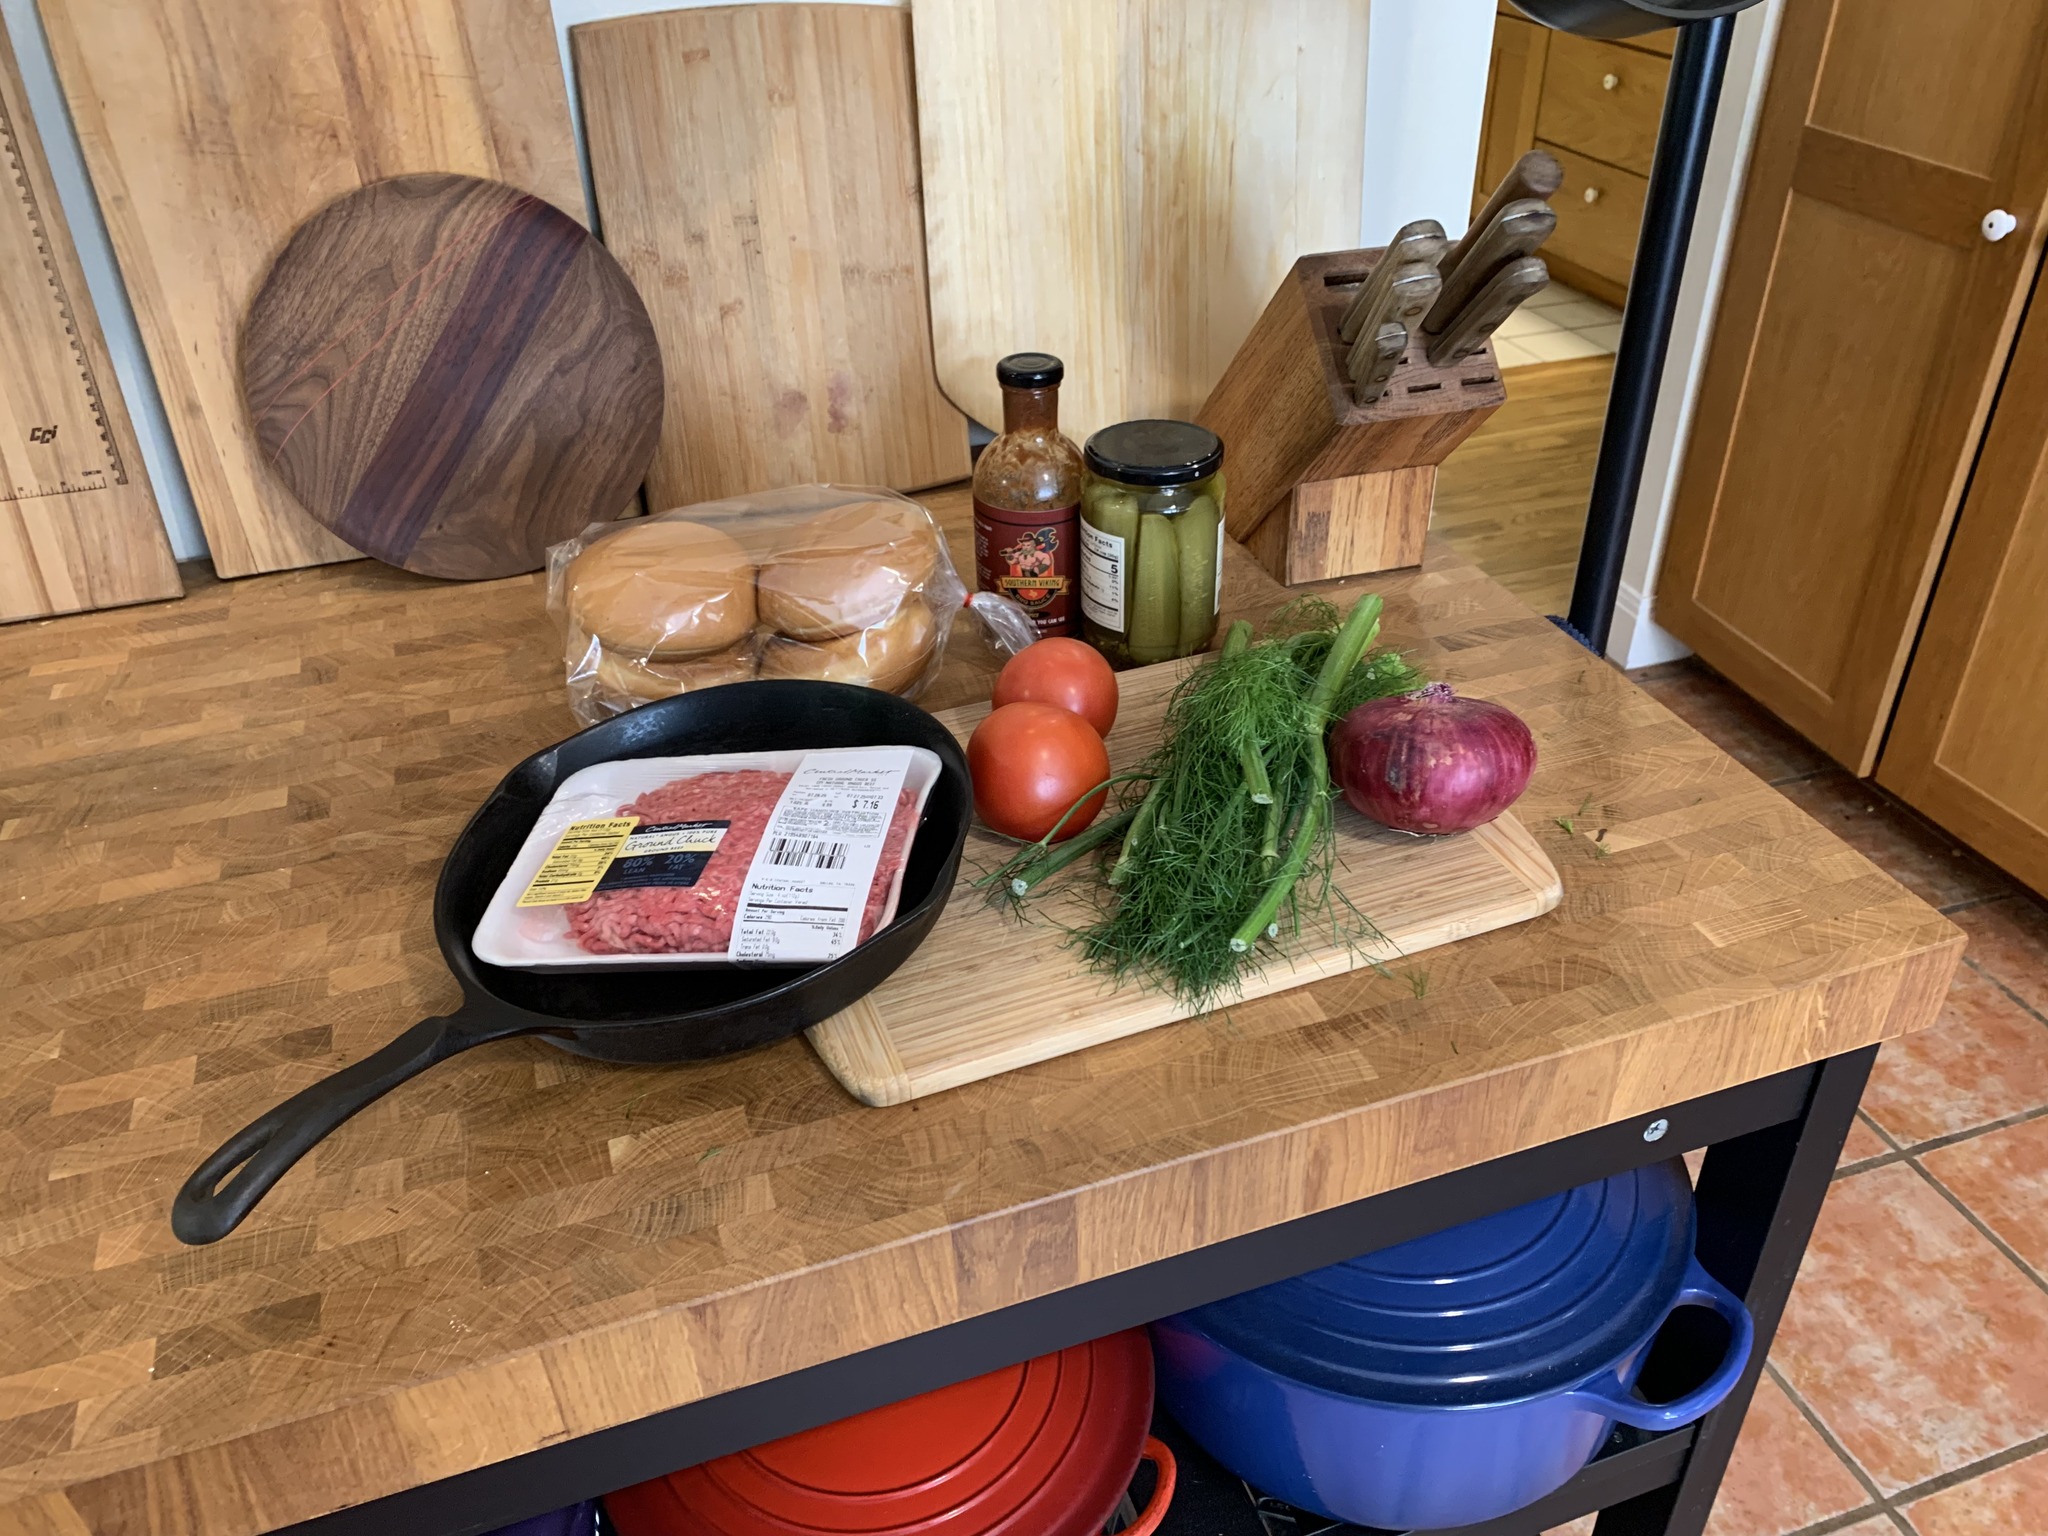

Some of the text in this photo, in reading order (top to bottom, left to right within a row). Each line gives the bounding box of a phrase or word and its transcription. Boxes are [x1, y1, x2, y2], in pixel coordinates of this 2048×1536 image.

[1111, 564, 1119, 574] 5
[1004, 578, 1060, 587] SOUTHERN VIKING
[852, 799, 880, 809] $ 7.16
[569, 823, 606, 832] Nutrition
[608, 821, 632, 830] Facts
[625, 832, 717, 852] Ground Chuck
[643, 846, 669, 854] GROUND
[622, 855, 656, 869] 80%
[664, 853, 698, 866] 20%
[622, 863, 686, 875] LEAN FAT
[751, 883, 814, 894] Nutrition Facts
[736, 950, 764, 958] Cholesterol
